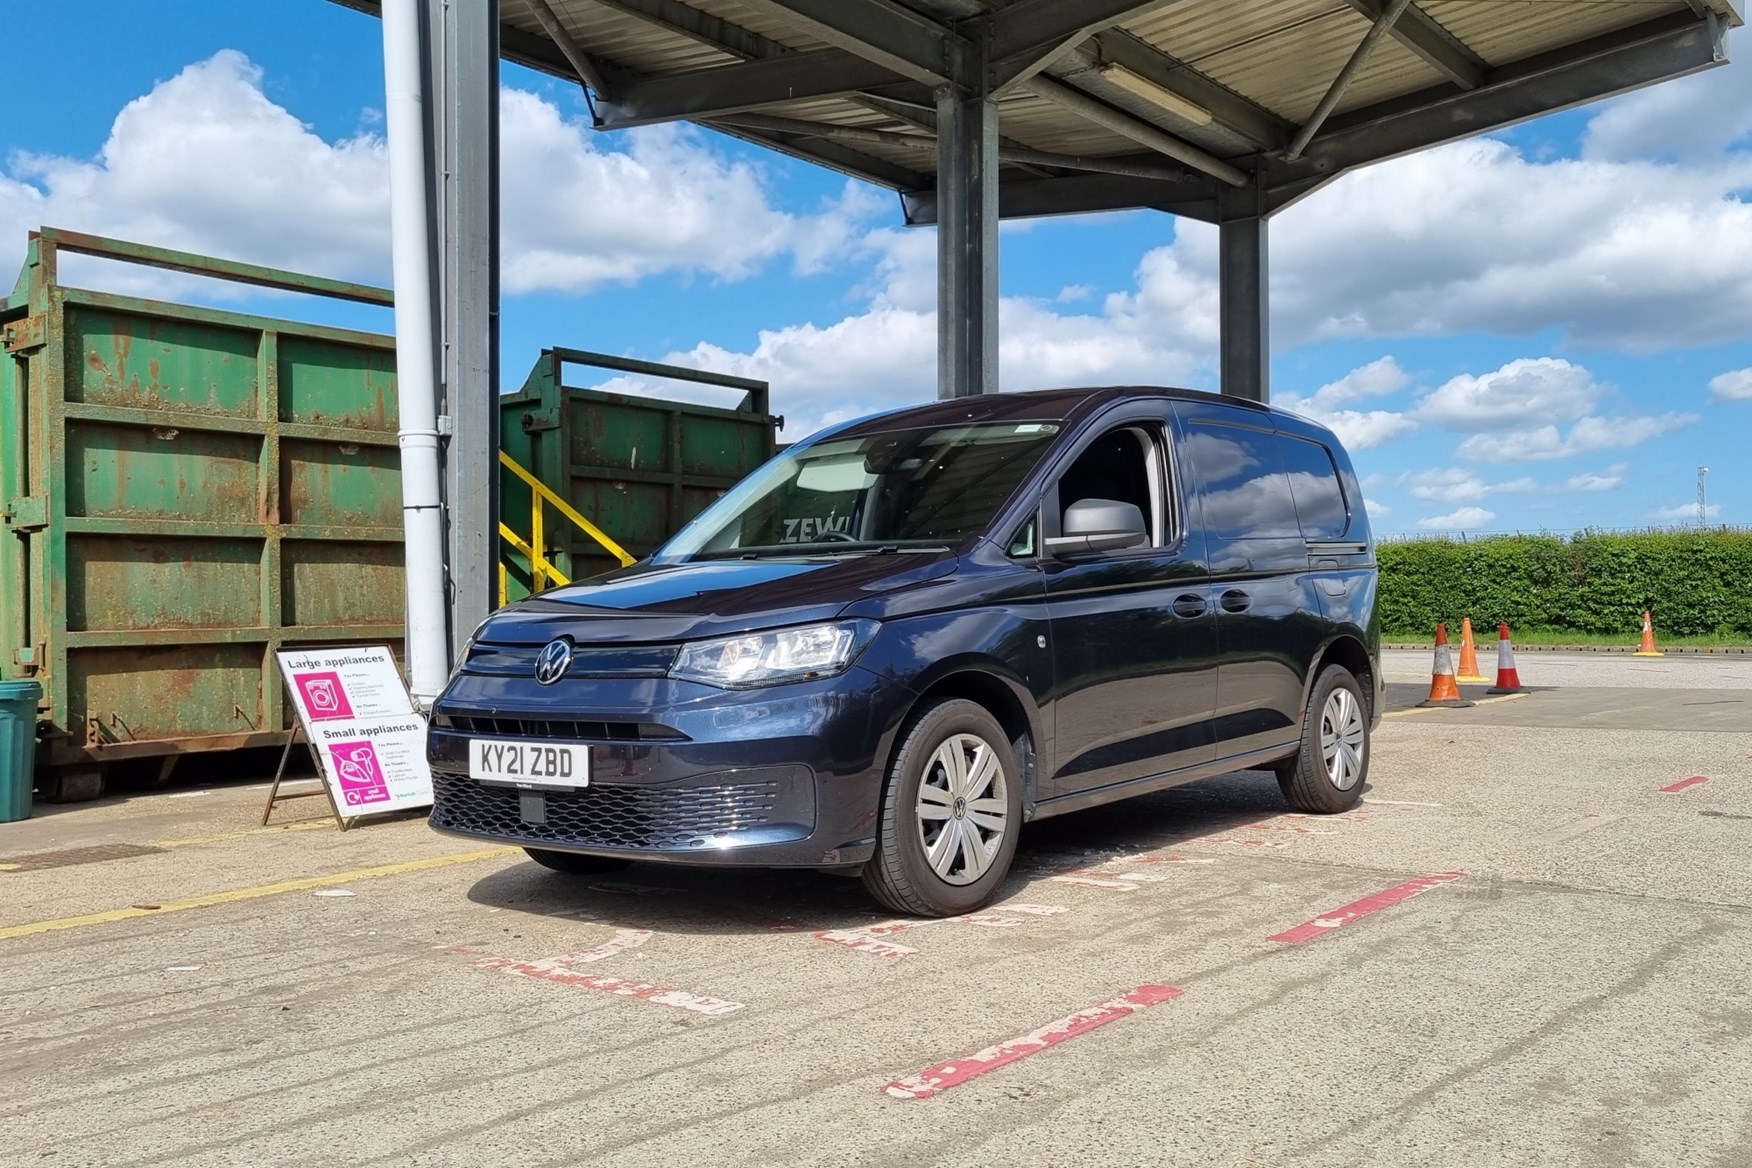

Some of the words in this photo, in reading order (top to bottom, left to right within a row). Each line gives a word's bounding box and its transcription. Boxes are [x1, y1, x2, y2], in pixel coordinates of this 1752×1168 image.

[288, 659, 321, 669] Large
[325, 655, 385, 667] appliances
[323, 728, 356, 739] Small
[360, 723, 419, 736] appliances
[481, 743, 524, 774] KY21
[530, 747, 572, 778] ZBD
